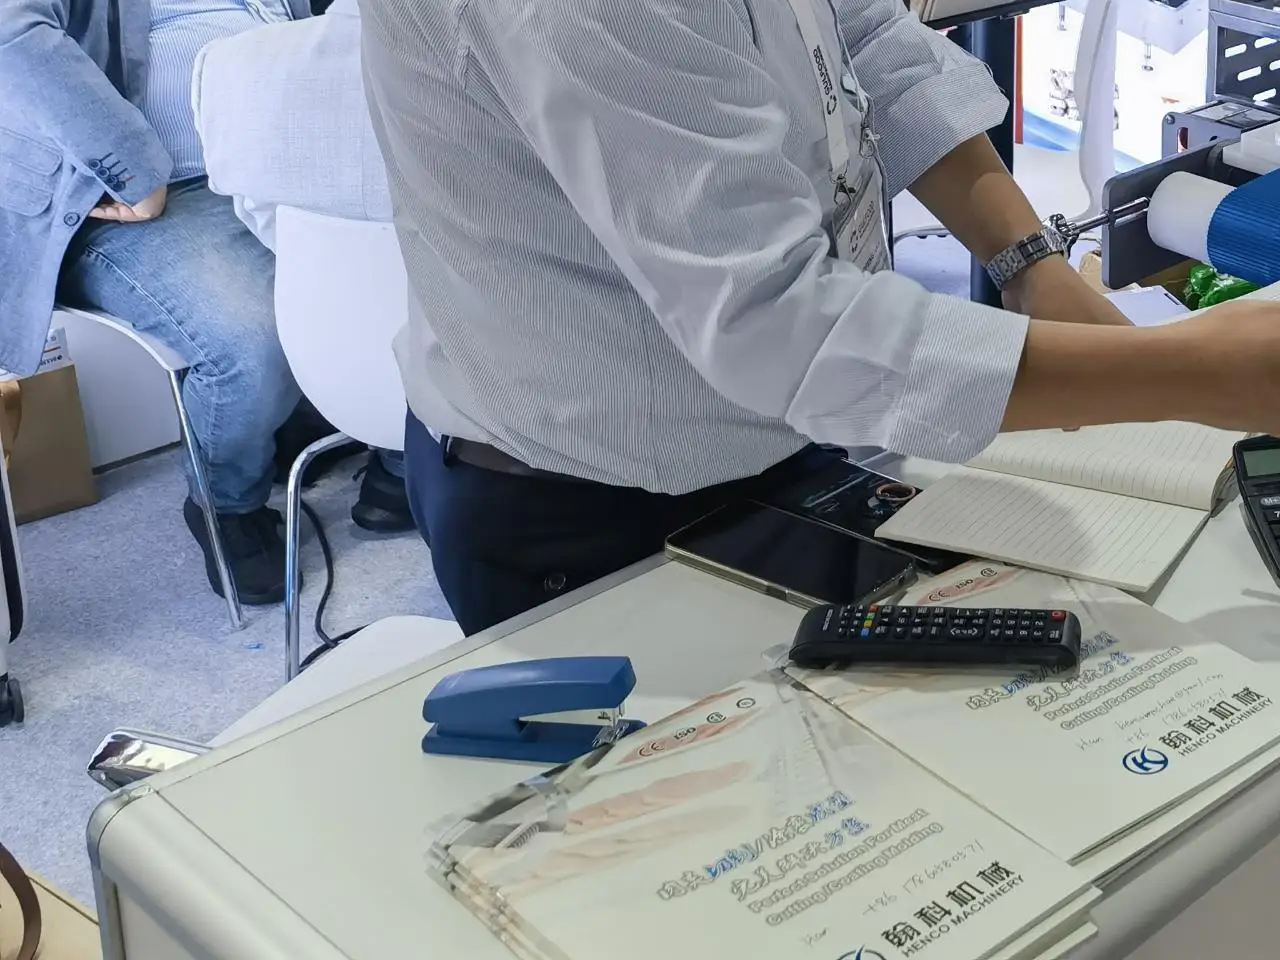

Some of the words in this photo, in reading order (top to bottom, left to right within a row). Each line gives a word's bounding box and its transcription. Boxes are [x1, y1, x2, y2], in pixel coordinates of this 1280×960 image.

[1043, 689, 1091, 721] Perfect
[1087, 665, 1136, 702] Solution
[1158, 686, 1265, 751] 翰科机械
[674, 727, 697, 740] ISO
[1178, 732, 1216, 756] HENCO
[1215, 699, 1274, 738] MACHINERY
[748, 874, 808, 914] Perfect
[805, 837, 870, 886] Solution
[893, 807, 931, 837] Meat
[881, 860, 1016, 948] 翰科机械
[901, 922, 950, 959] HENCO
[950, 873, 1026, 928] MACHINERY
